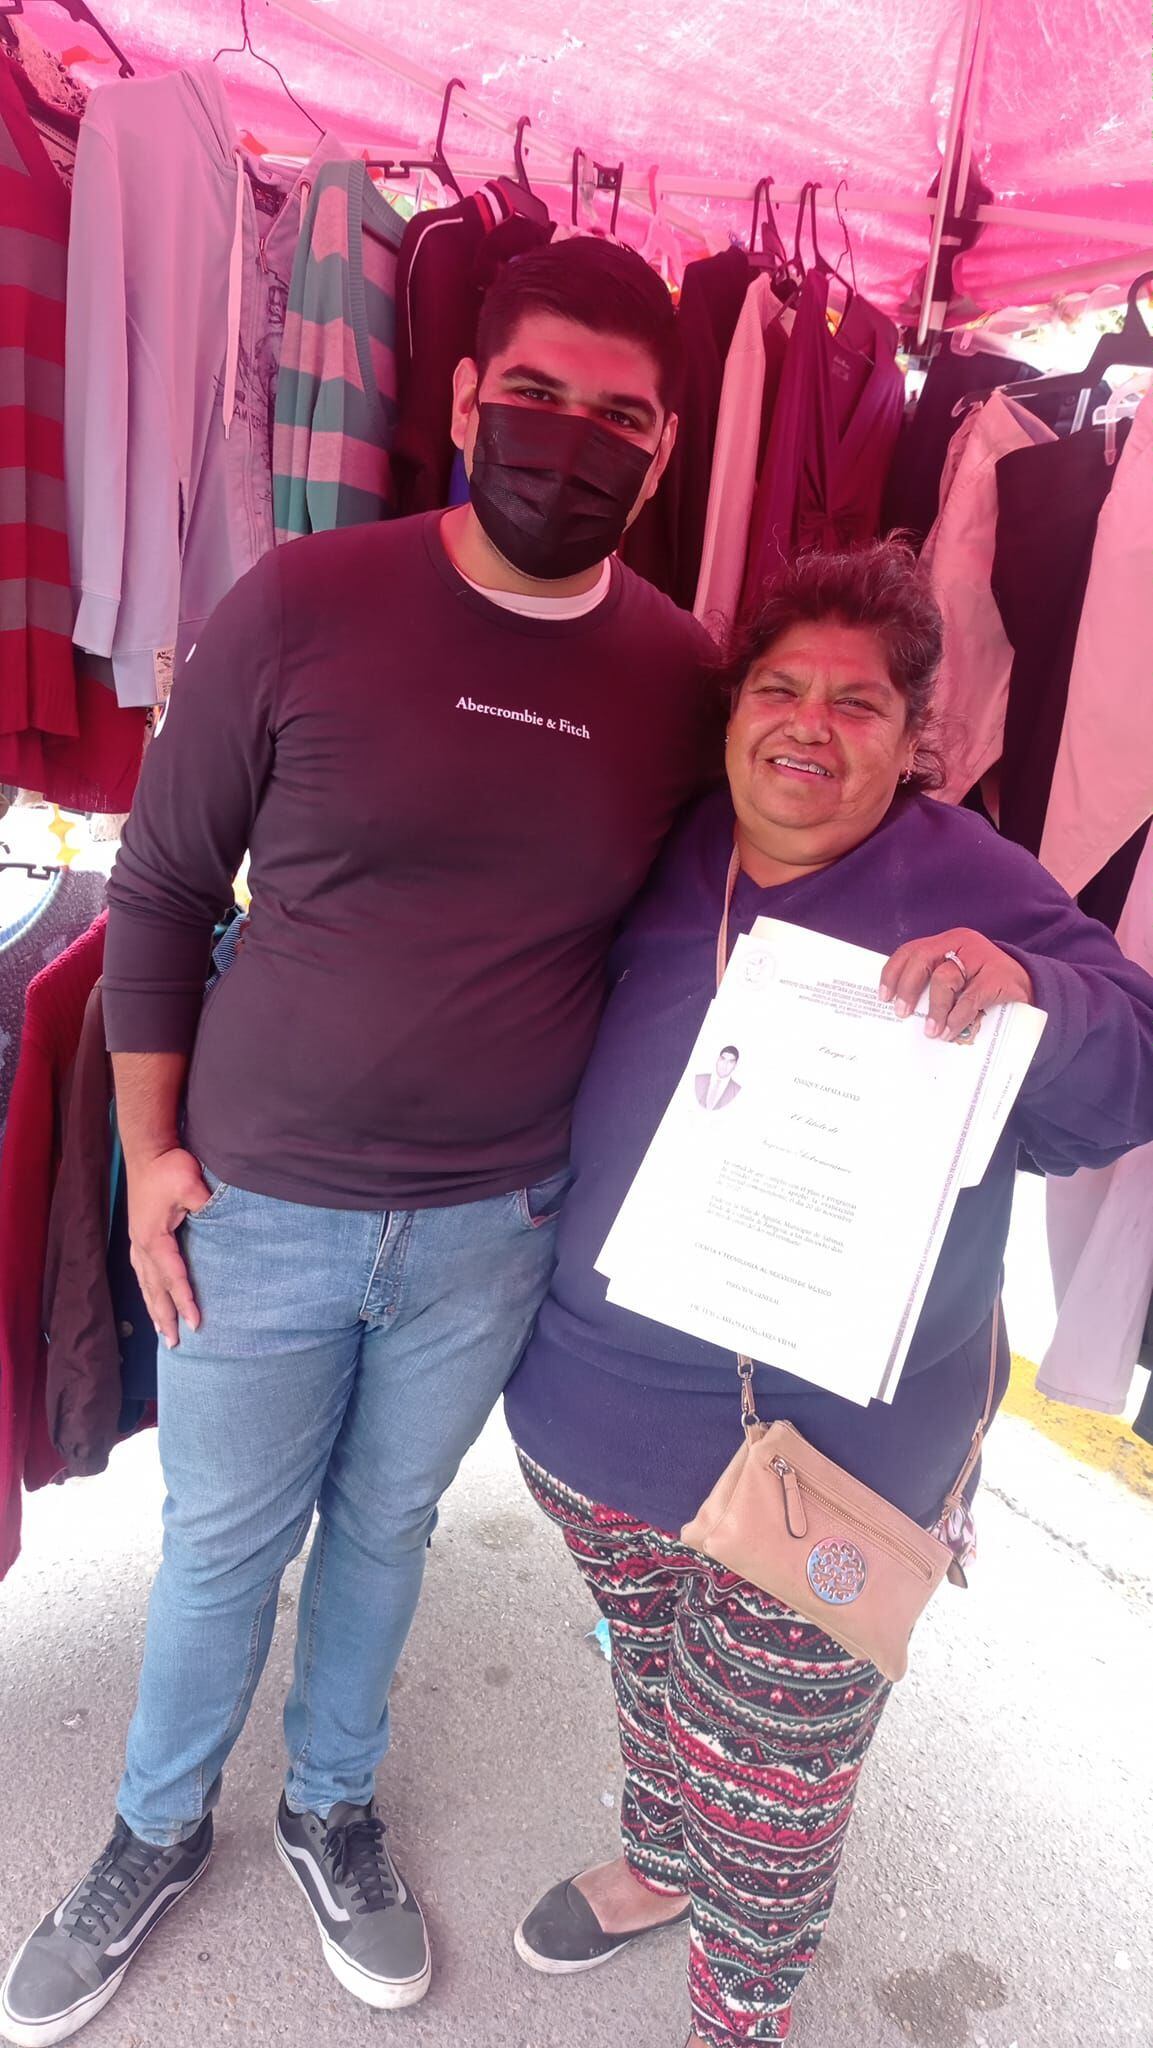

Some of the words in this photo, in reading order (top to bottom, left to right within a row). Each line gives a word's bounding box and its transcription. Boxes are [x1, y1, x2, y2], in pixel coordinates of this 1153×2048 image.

[456, 697, 544, 726] Abercrombie
[546, 718, 556, 730] &
[559, 719, 591, 739] Fitch
